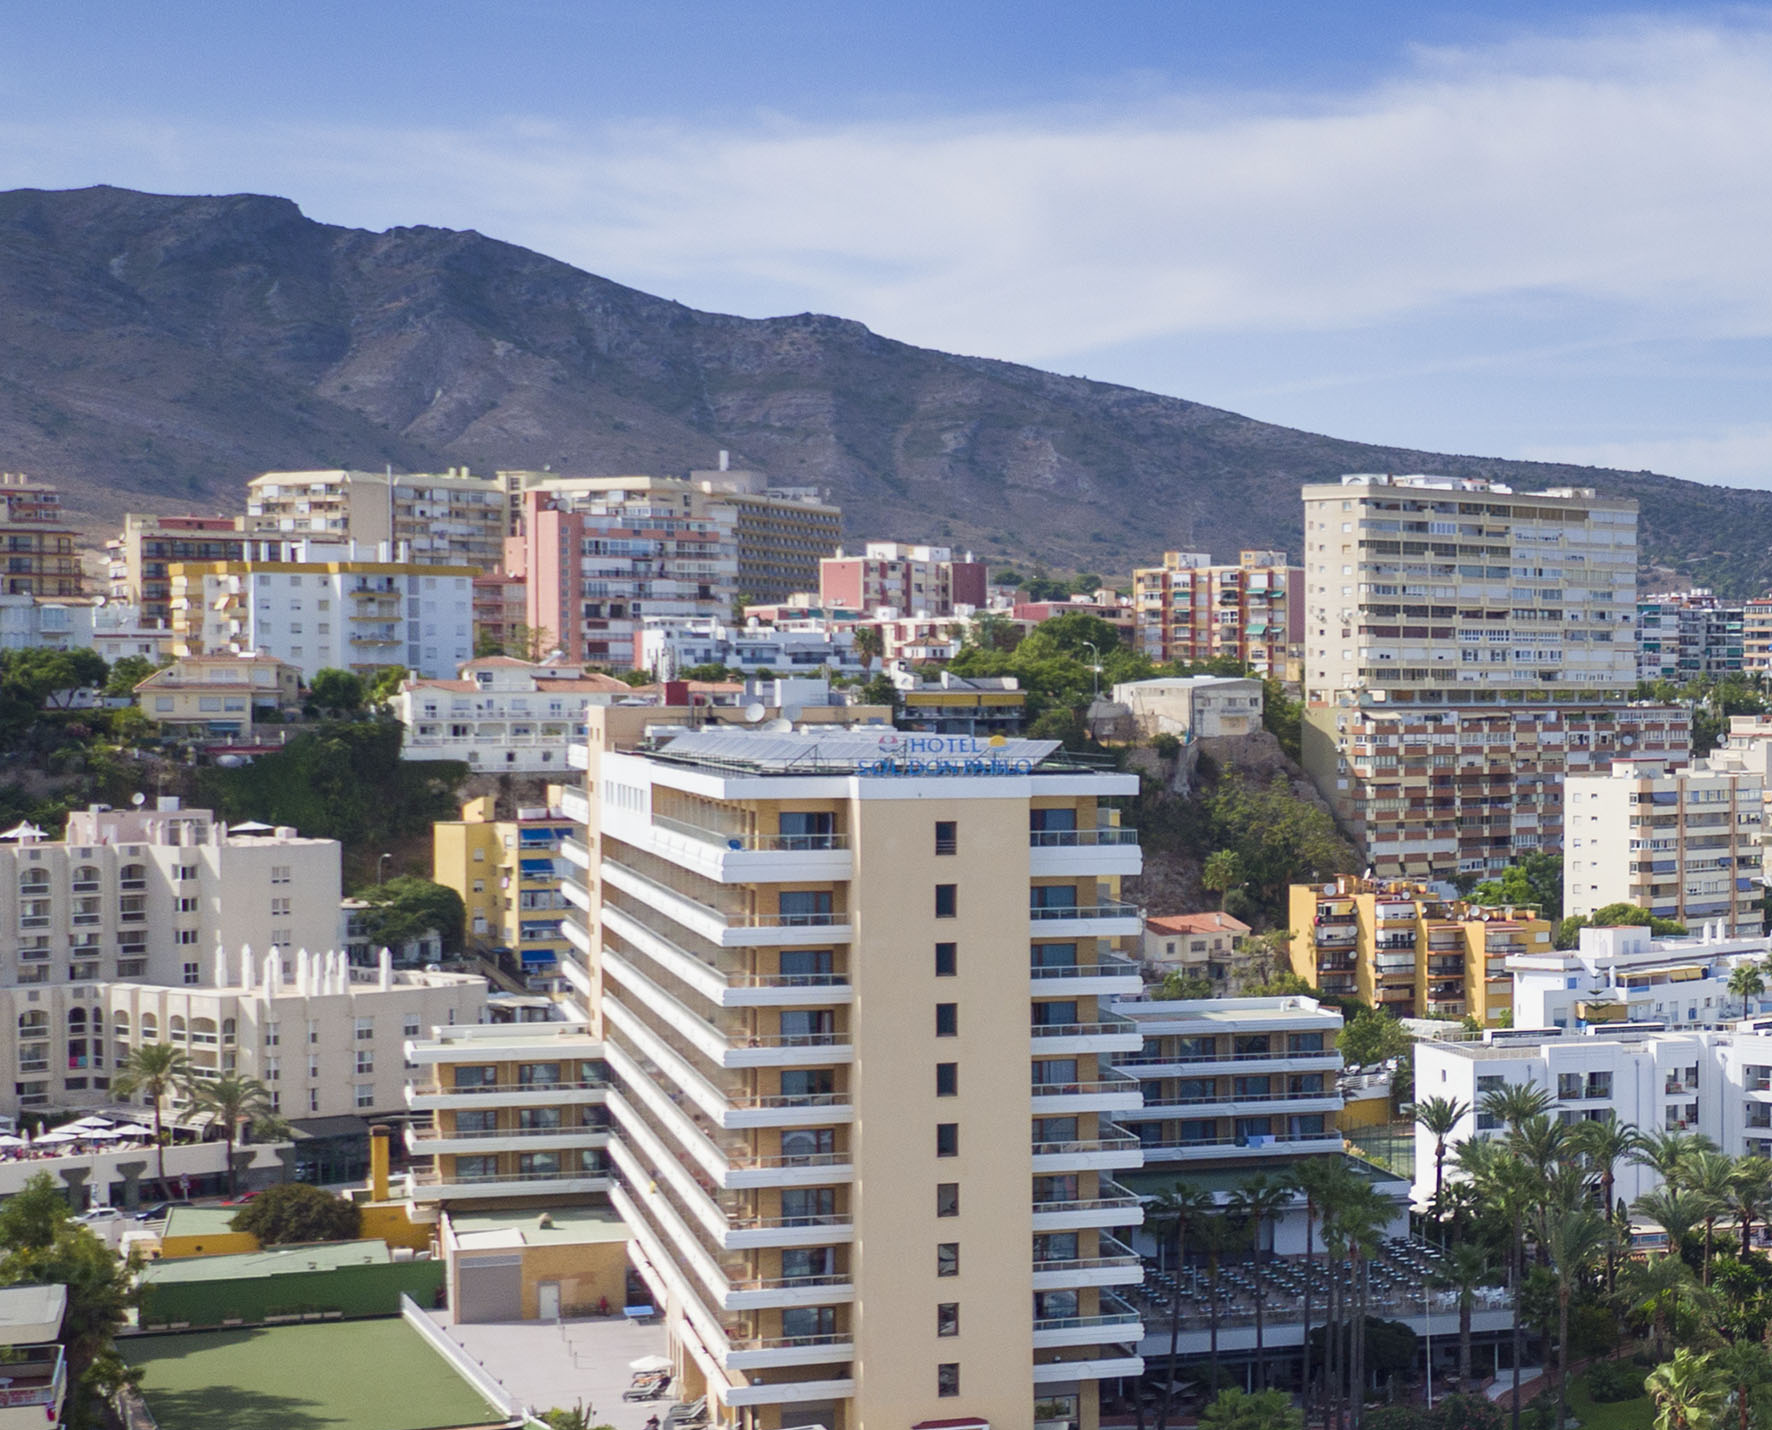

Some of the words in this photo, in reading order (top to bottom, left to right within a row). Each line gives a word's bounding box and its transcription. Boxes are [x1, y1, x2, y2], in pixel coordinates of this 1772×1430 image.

[911, 737, 982, 753] HOTEL
[856, 759, 900, 776] SOL
[909, 759, 959, 776] DON
[964, 758, 1033, 776] PABLO
